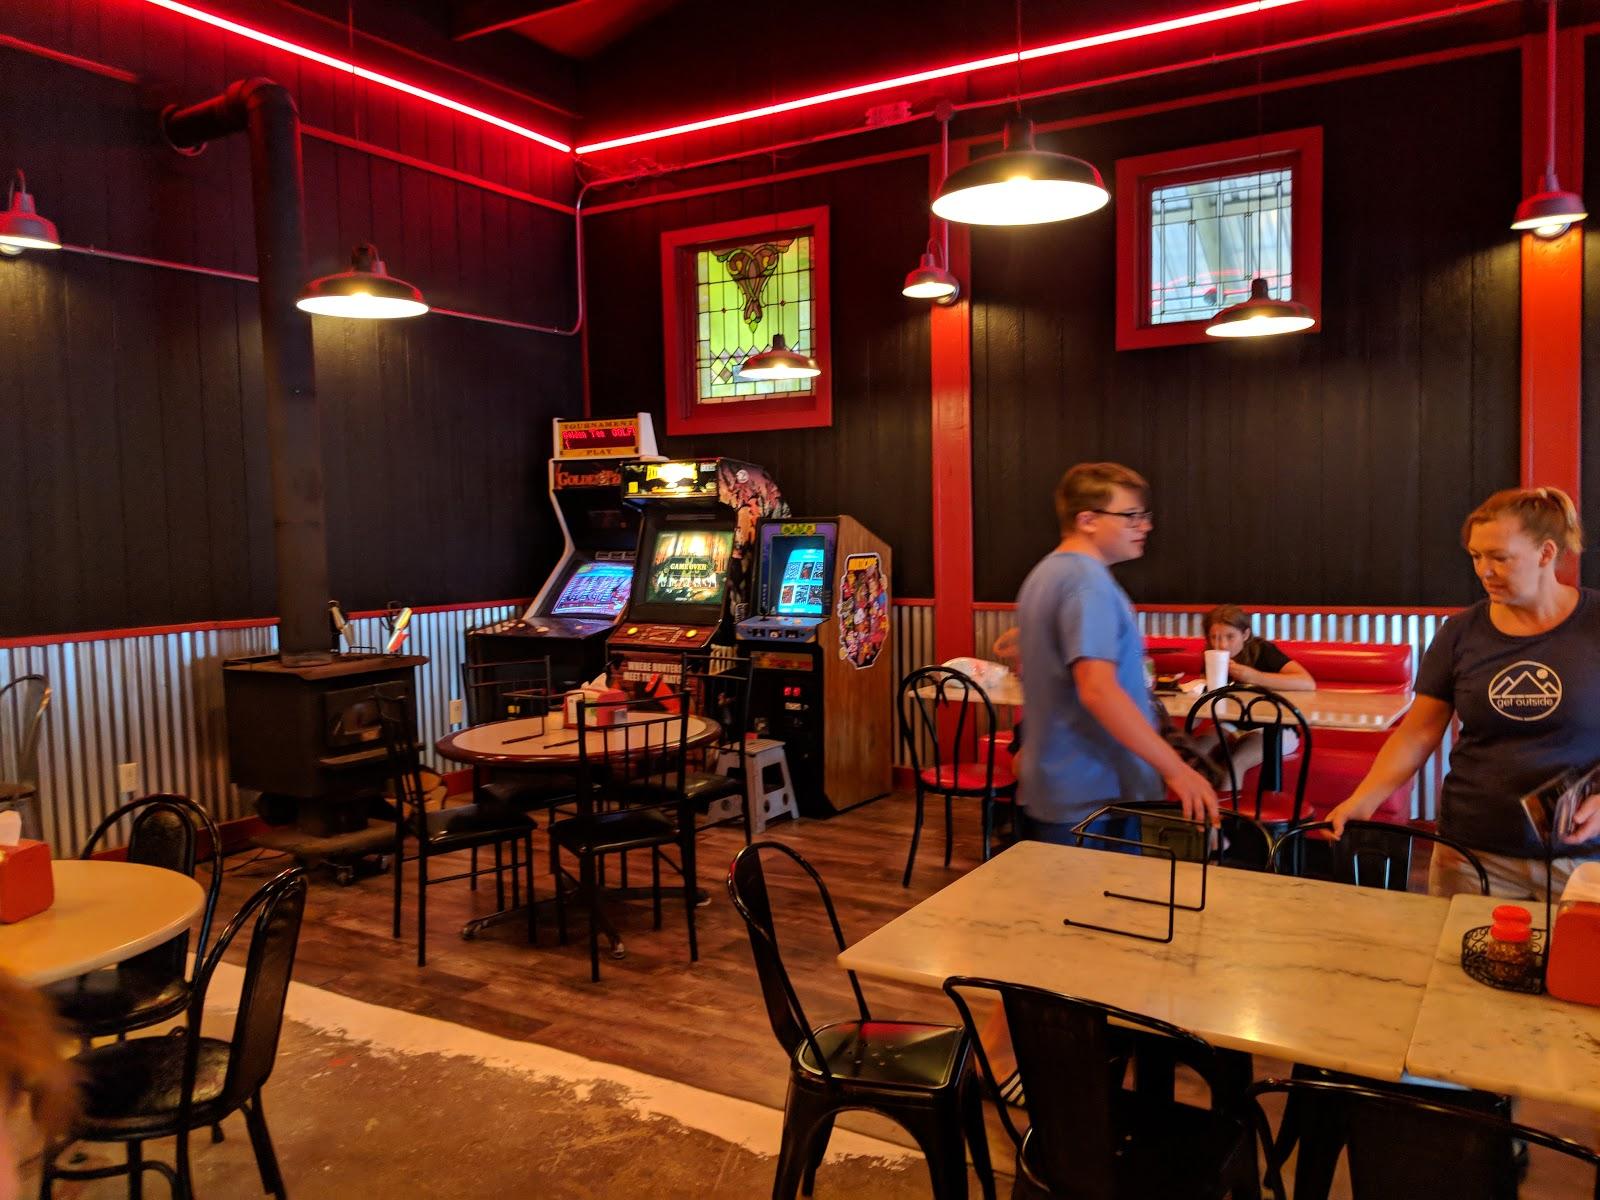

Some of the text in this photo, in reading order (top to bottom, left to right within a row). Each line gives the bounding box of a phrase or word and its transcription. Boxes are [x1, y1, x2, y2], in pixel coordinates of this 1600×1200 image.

[563, 421, 634, 430] TOURNAMENT
[627, 661, 652, 672] WHERE
[623, 671, 640, 682] MEET
[1497, 697, 1554, 709] get outside
